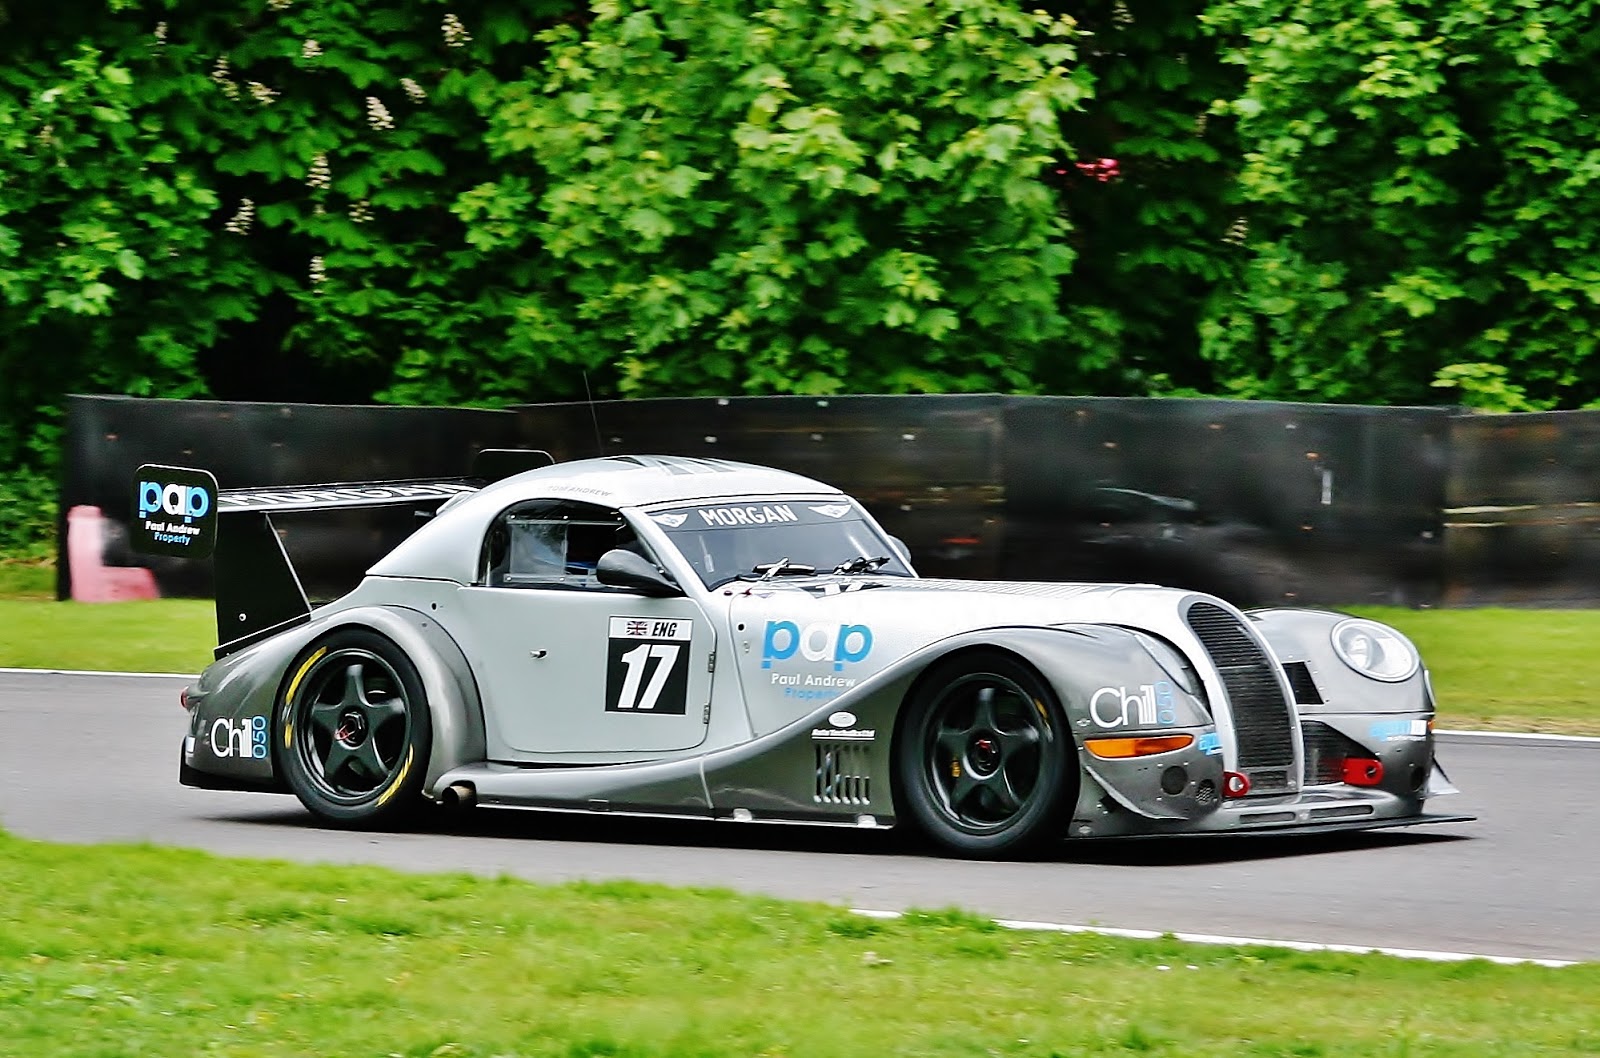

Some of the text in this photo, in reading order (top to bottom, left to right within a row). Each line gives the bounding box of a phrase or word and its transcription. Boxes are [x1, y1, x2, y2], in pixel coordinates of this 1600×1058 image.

[139, 481, 209, 523] pap
[698, 504, 798, 526] MORGAN
[145, 520, 200, 535] Paul Andrew
[154, 531, 190, 546] Property
[652, 622, 678, 637] ENG
[761, 619, 874, 672] pap
[617, 643, 681, 709] 17
[771, 672, 856, 687] Paul Andrew
[1089, 684, 1157, 729] Chill
